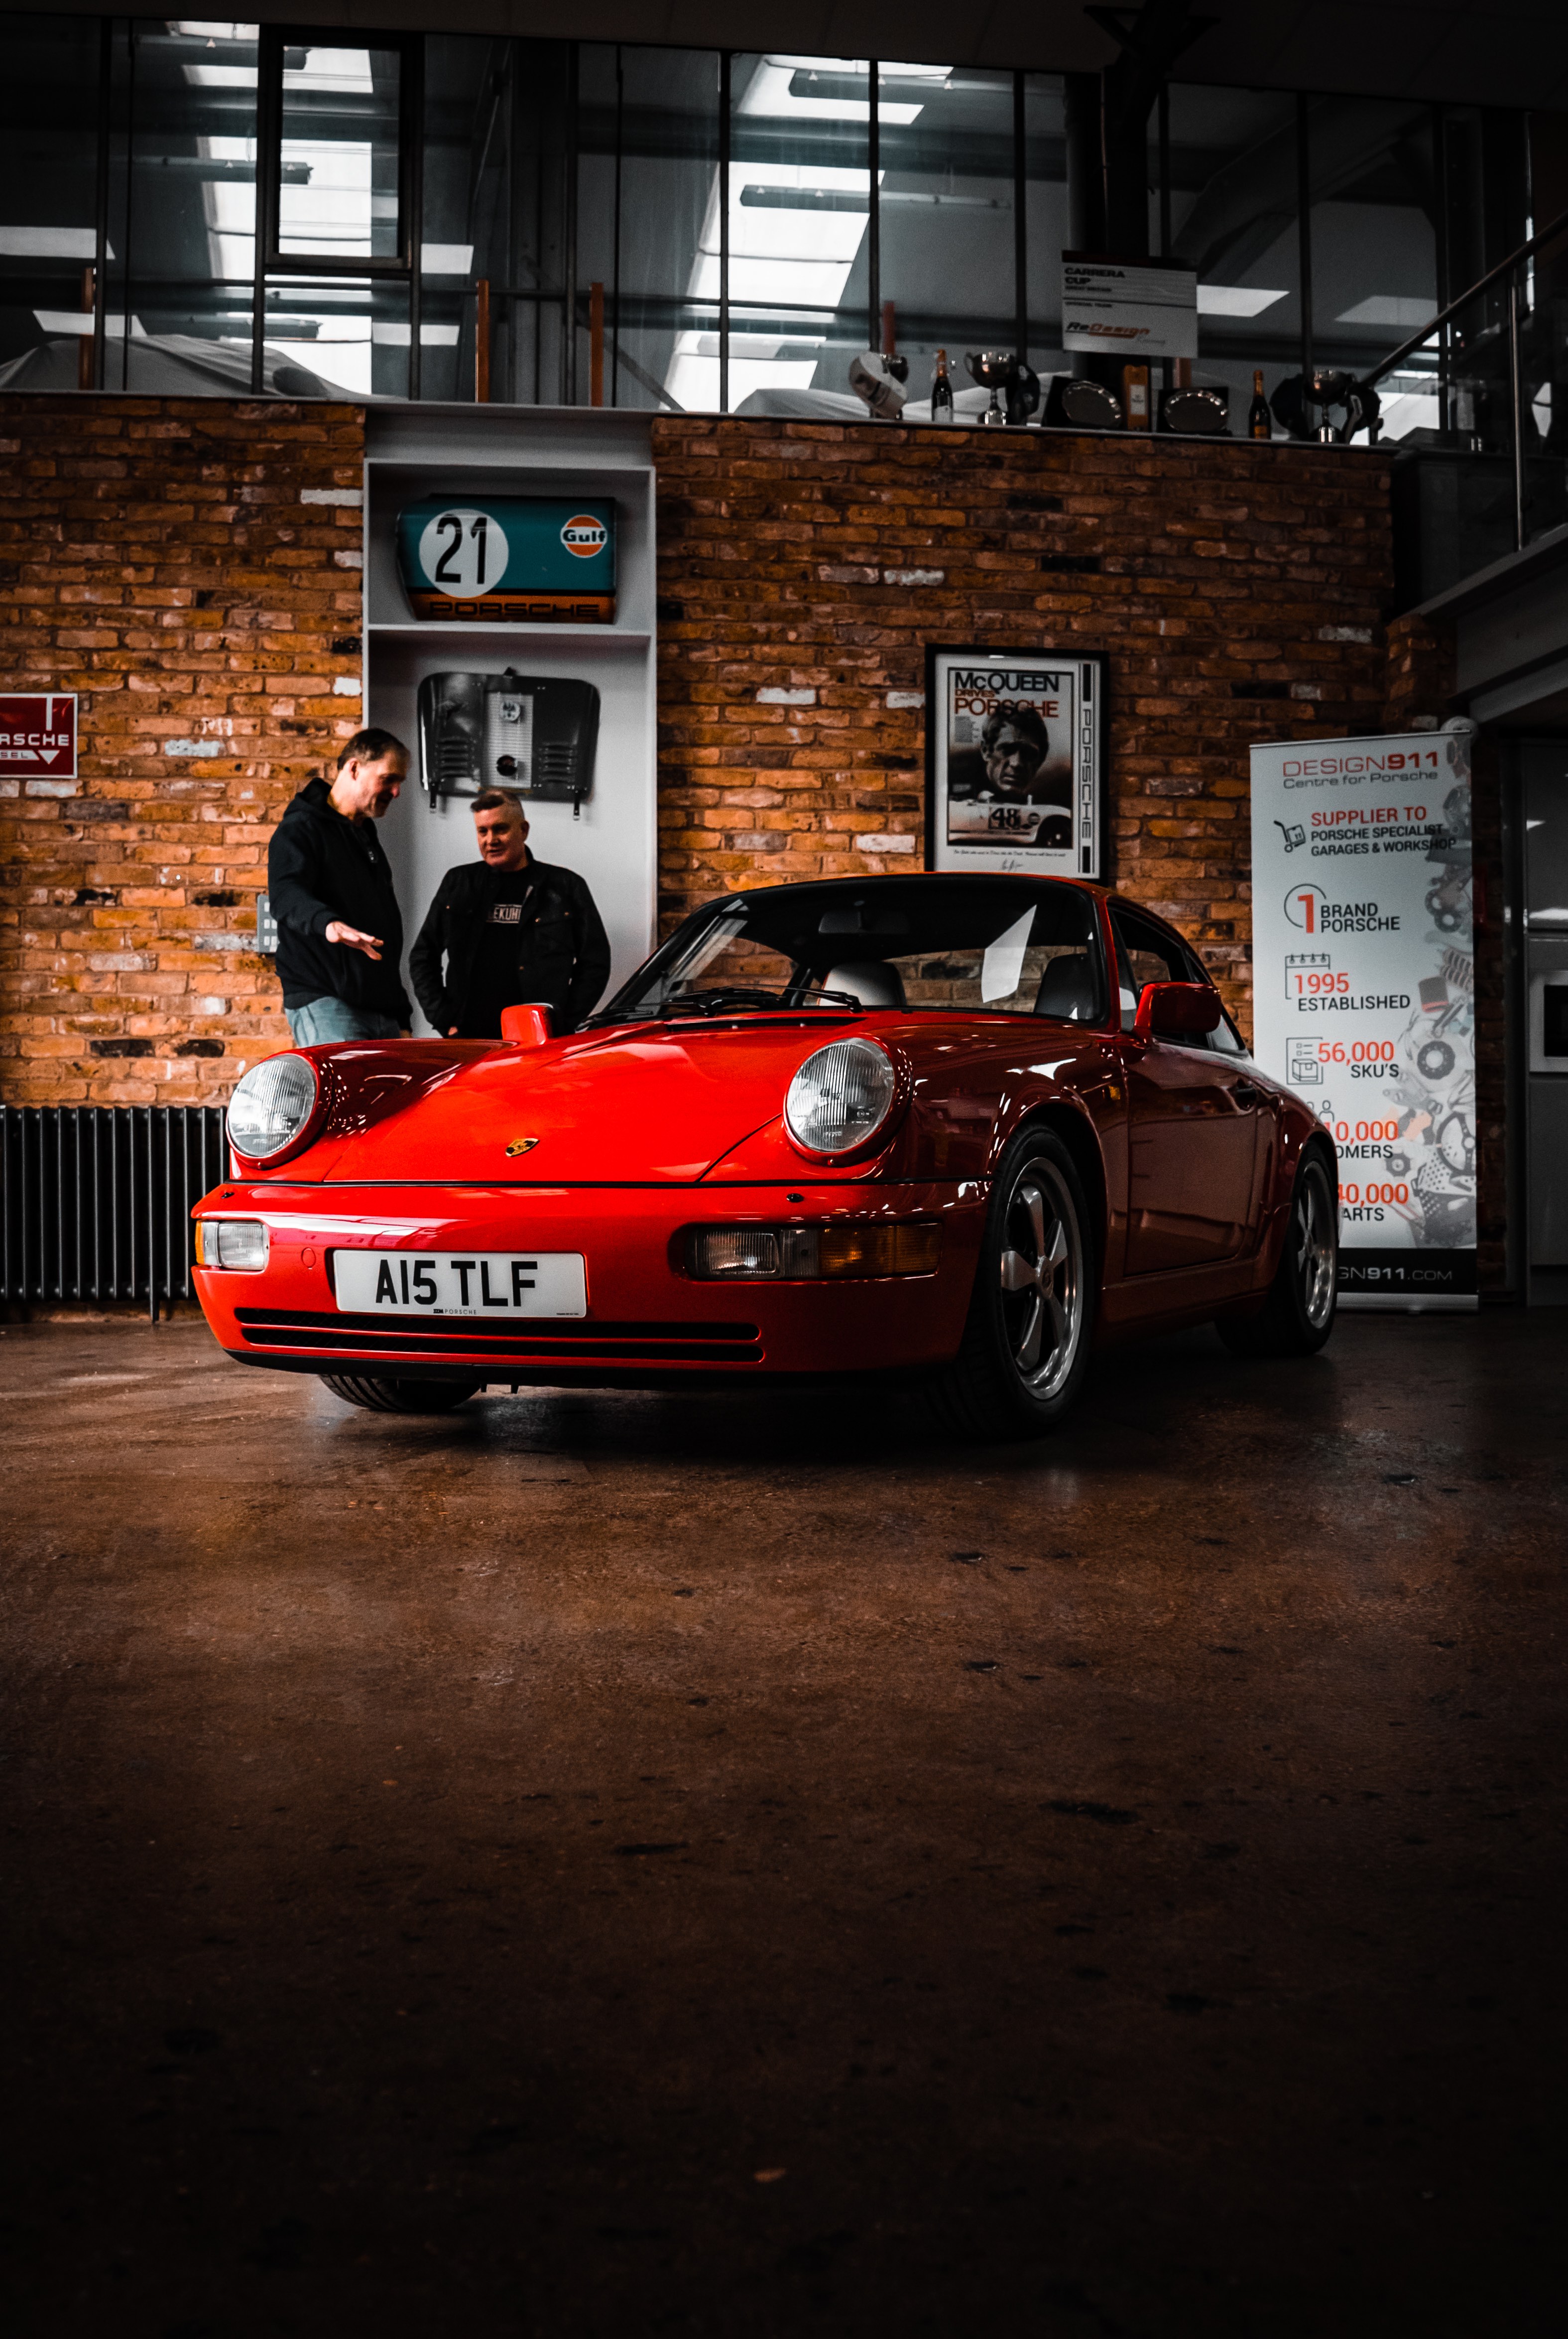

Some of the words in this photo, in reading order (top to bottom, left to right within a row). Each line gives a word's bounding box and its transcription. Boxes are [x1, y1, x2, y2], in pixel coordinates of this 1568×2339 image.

[1064, 267, 1125, 278] CARRERA
[563, 529, 607, 542] Gulf
[435, 514, 487, 584] 21
[430, 602, 600, 617] PORSCHE
[955, 672, 1059, 694] McQUEEN
[955, 698, 1059, 718] PORSCHE
[1082, 709, 1092, 839] PORSCHE
[1283, 752, 1438, 777] DESIGN911
[1283, 777, 1338, 789] Centre
[1342, 775, 1365, 785] for
[1370, 771, 1438, 783] Porsche
[991, 808, 1020, 828] 48
[1311, 808, 1398, 827] SUPPLIER
[1403, 806, 1427, 821] TO
[1311, 828, 1369, 842] PORSCHE
[1373, 824, 1443, 838] SPECIALIST
[1311, 843, 1369, 857] GARAGES
[1372, 842, 1380, 854] &
[1383, 838, 1455, 853] WORKSHOP
[1298, 894, 1314, 933] 1
[1321, 903, 1378, 918] BRAND
[1321, 917, 1400, 933] PORSCHE
[1295, 973, 1350, 994] 1995
[1298, 995, 1410, 1011] ESTABLISHED
[1318, 1041, 1394, 1066] 56,000
[1350, 1064, 1399, 1078] SKU'S
[376, 1259, 437, 1305] A15
[451, 1261, 538, 1307] TLF
